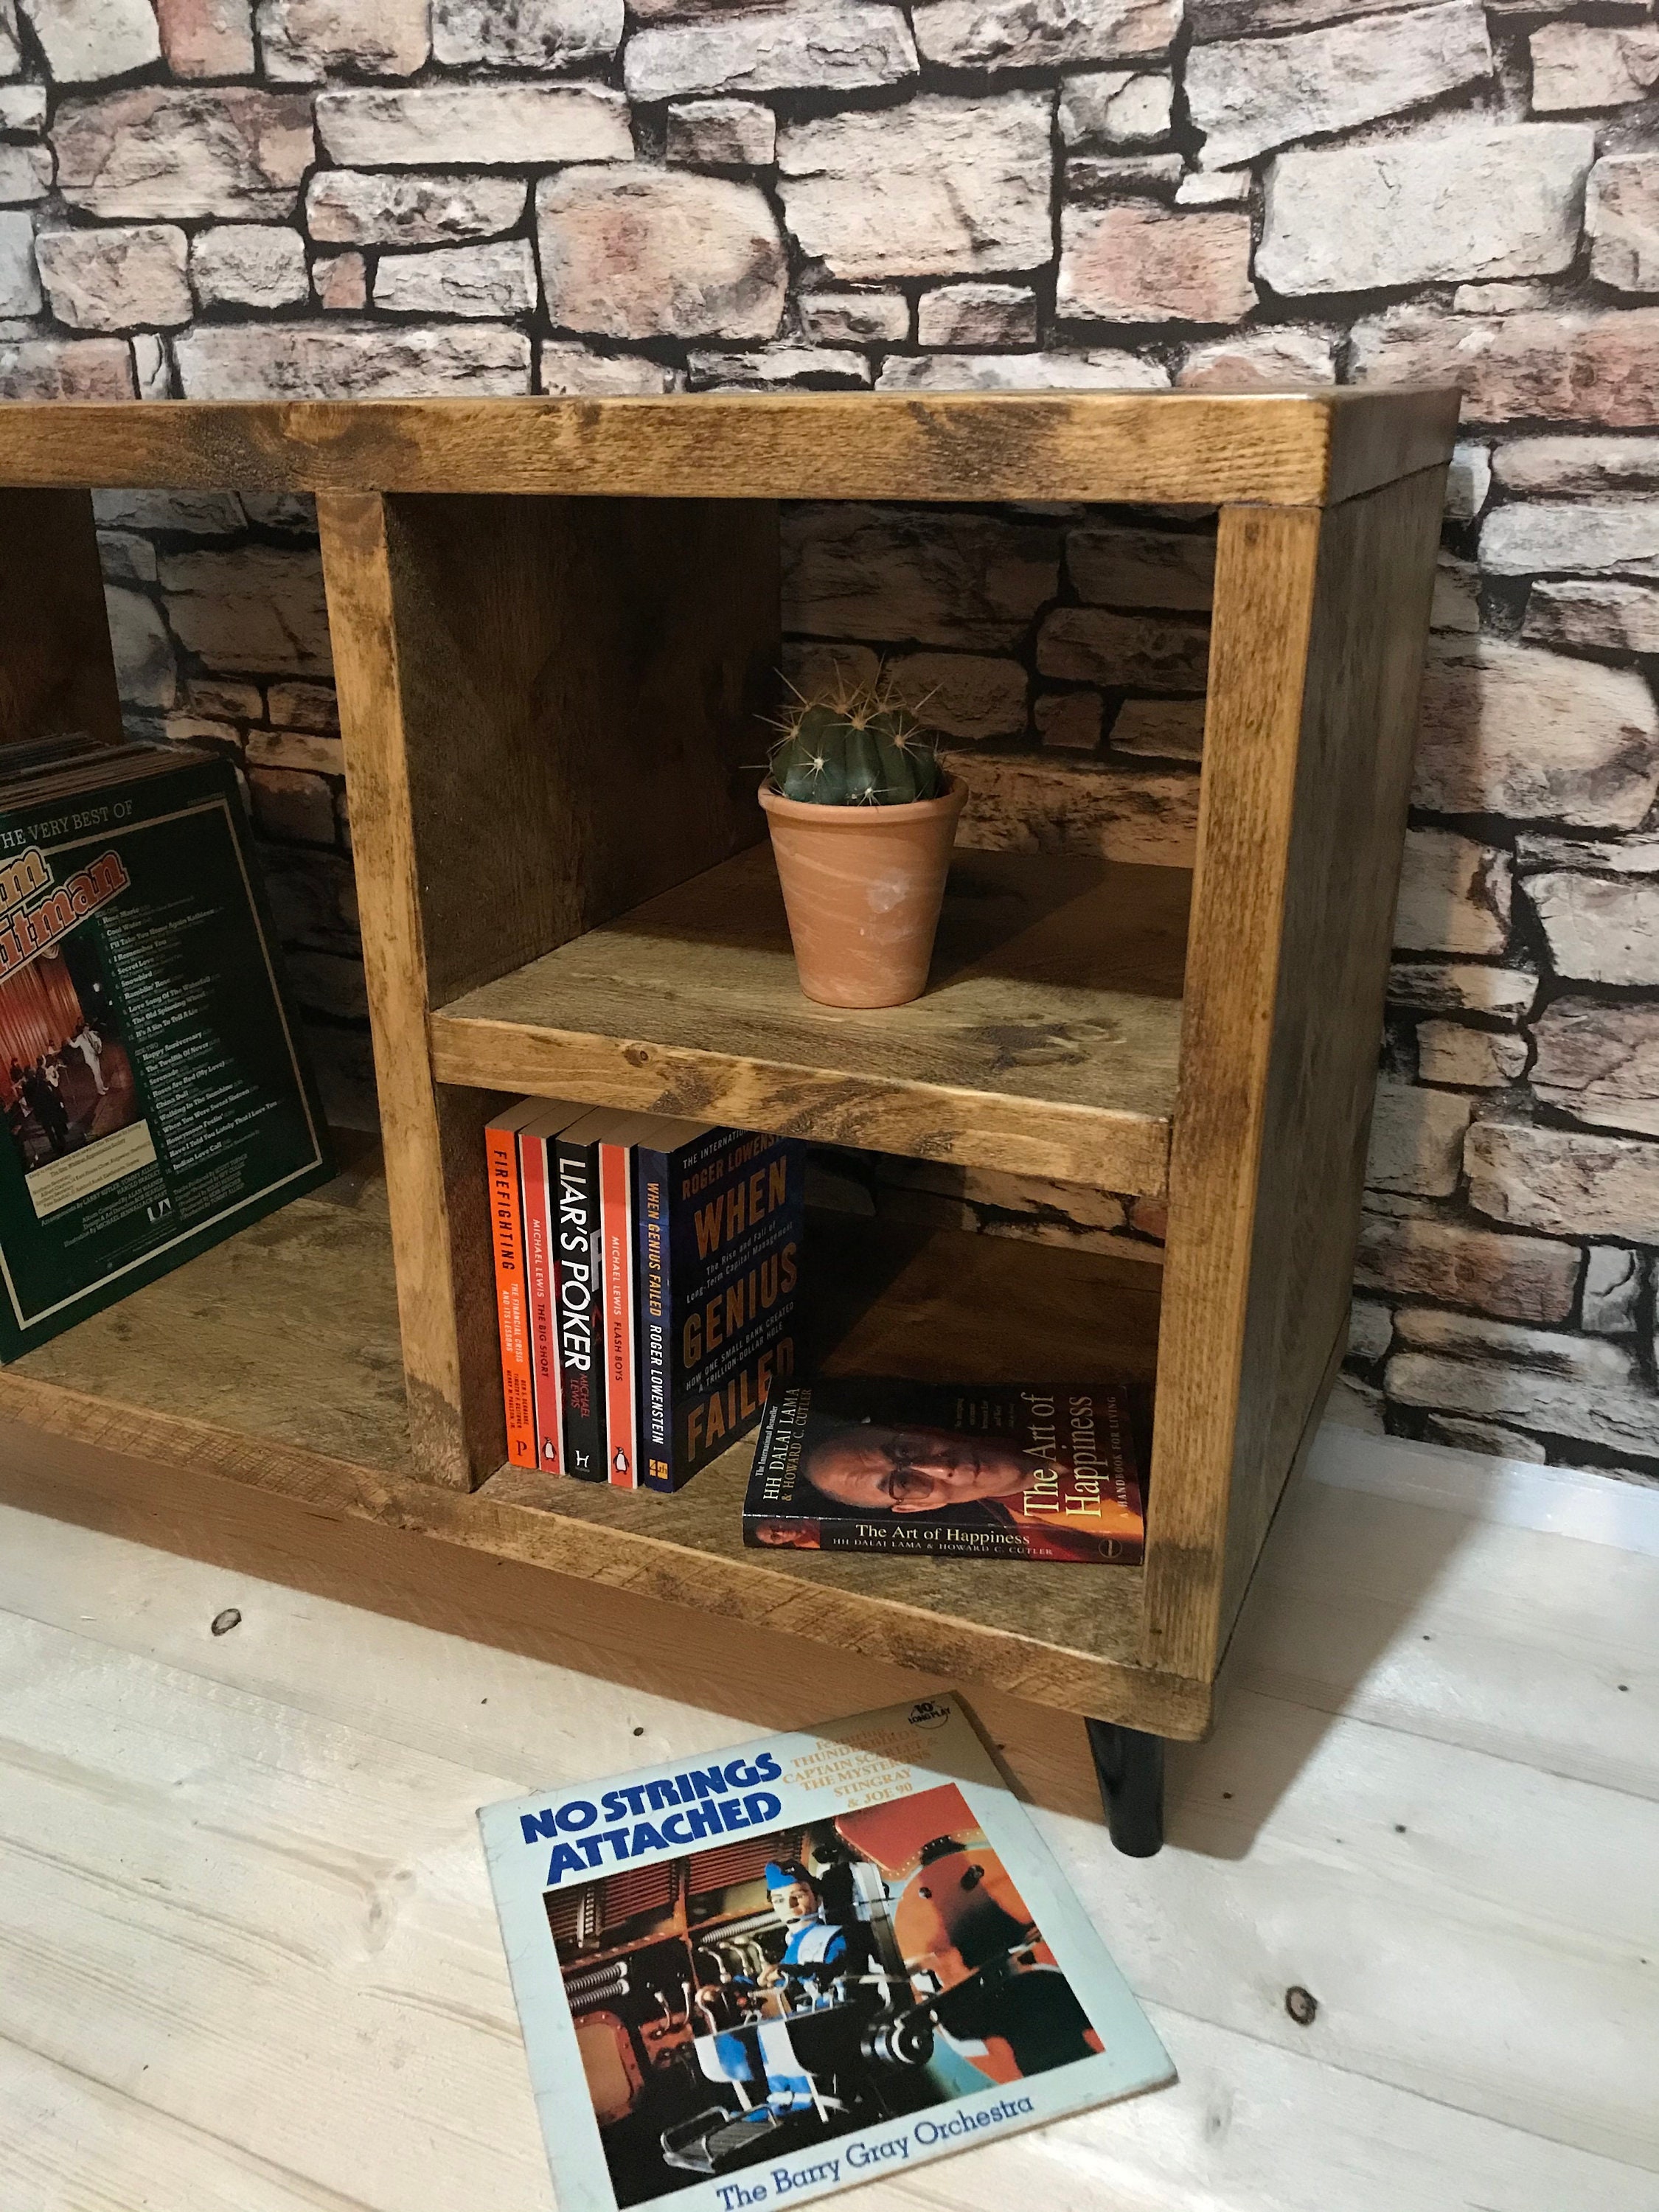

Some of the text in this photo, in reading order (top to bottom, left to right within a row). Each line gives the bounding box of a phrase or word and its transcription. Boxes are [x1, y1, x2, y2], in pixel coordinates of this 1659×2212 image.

[0, 799, 133, 849] HE VERY BEST OF
[0, 852, 127, 979] itman
[120, 970, 153, 988] Snowbird
[128, 1003, 145, 1013] Love
[145, 996, 163, 1007] Song
[169, 988, 183, 996] The
[131, 990, 206, 1026] The Old Spinning Wheel
[142, 1048, 164, 1061] Happy
[164, 1032, 202, 1052] Anniversary
[145, 1042, 209, 1073] The Twelfth Of Never
[149, 1069, 179, 1086] Serenade
[152, 1085, 173, 1097] Roses
[172, 1080, 183, 1089] Are
[183, 1073, 196, 1084] Red
[156, 1090, 189, 1110] China Doll
[159, 1106, 187, 1121] Walking
[186, 1102, 194, 1110] In
[193, 1096, 206, 1106] The
[162, 1121, 182, 1133] When
[181, 1116, 195, 1124] You
[193, 1107, 211, 1119] Were
[209, 1099, 229, 1111] Sweet
[166, 1124, 204, 1146] Honeymoon
[169, 1147, 187, 1158] Have
[189, 1136, 204, 1147] Told
[204, 1131, 216, 1141] You
[234, 1114, 248, 1126] That
[251, 1107, 266, 1117] Love
[265, 1101, 278, 1110] You
[173, 1141, 223, 1171] Indian Love Call
[683, 1153, 698, 1170] THE
[681, 1158, 725, 1202] ROGER
[494, 1150, 515, 1270] FIREFIGHTING
[693, 1155, 787, 1262] WHEN
[559, 1158, 591, 1371] LIAR'S POKER
[686, 1220, 793, 1304] Long-Term Capital Management
[706, 1220, 776, 1276] The Rise and Fall of
[512, 1298, 521, 1336] FINANCIAL
[532, 1218, 549, 1378] MICHAEL LEWIS THE BIG SHORT
[611, 1235, 624, 1382] MICHAEL LEWIS FLASH BOYS
[647, 1182, 664, 1445] WHEN GENIUS FAILED ROGER LOWENSTEIN
[683, 1242, 799, 1369] GENIUS
[505, 1319, 513, 1352] LESSONS
[515, 1337, 524, 1363] CRISIS
[686, 1300, 796, 1392] HOW ONE SMALL BANK CREATED
[698, 1382, 705, 1394] A
[765, 1321, 784, 1345] HOLE
[570, 1379, 580, 1409] LEWIS
[580, 1373, 590, 1419] MICHAEL
[686, 1336, 795, 1464] FAILED
[1107, 1396, 1120, 1429] LIVING
[755, 1405, 779, 1476] The International Bestseller
[763, 1388, 801, 1500] HH DALAI LAMA
[782, 1388, 813, 1503] & HOWARD C. CUTLER
[1020, 1391, 1060, 1517] The Art of
[1060, 1396, 1110, 1518] Happiness
[1110, 1431, 1121, 1451] FOR
[1113, 1452, 1129, 1508] HANDBOOK
[854, 1539, 887, 1547] DALAI
[939, 1543, 990, 1551] HOWARD
[1009, 1547, 1054, 1556] CUTLER
[855, 1524, 1031, 1546] The Art of Happiness
[907, 1706, 952, 1725] LONG PLAY
[782, 1758, 853, 1784] CAPTAIN
[855, 1739, 923, 1765] SCARLET
[800, 1750, 931, 1792] THE MYSTERONS
[833, 1768, 912, 1798] STINGRAY
[520, 1752, 782, 1845] NO STRINGS
[847, 1781, 914, 1809] & JOE 90
[547, 1792, 782, 1886] ATTACHED
[717, 2096, 1034, 2212] The Barry Gray Orchestra
